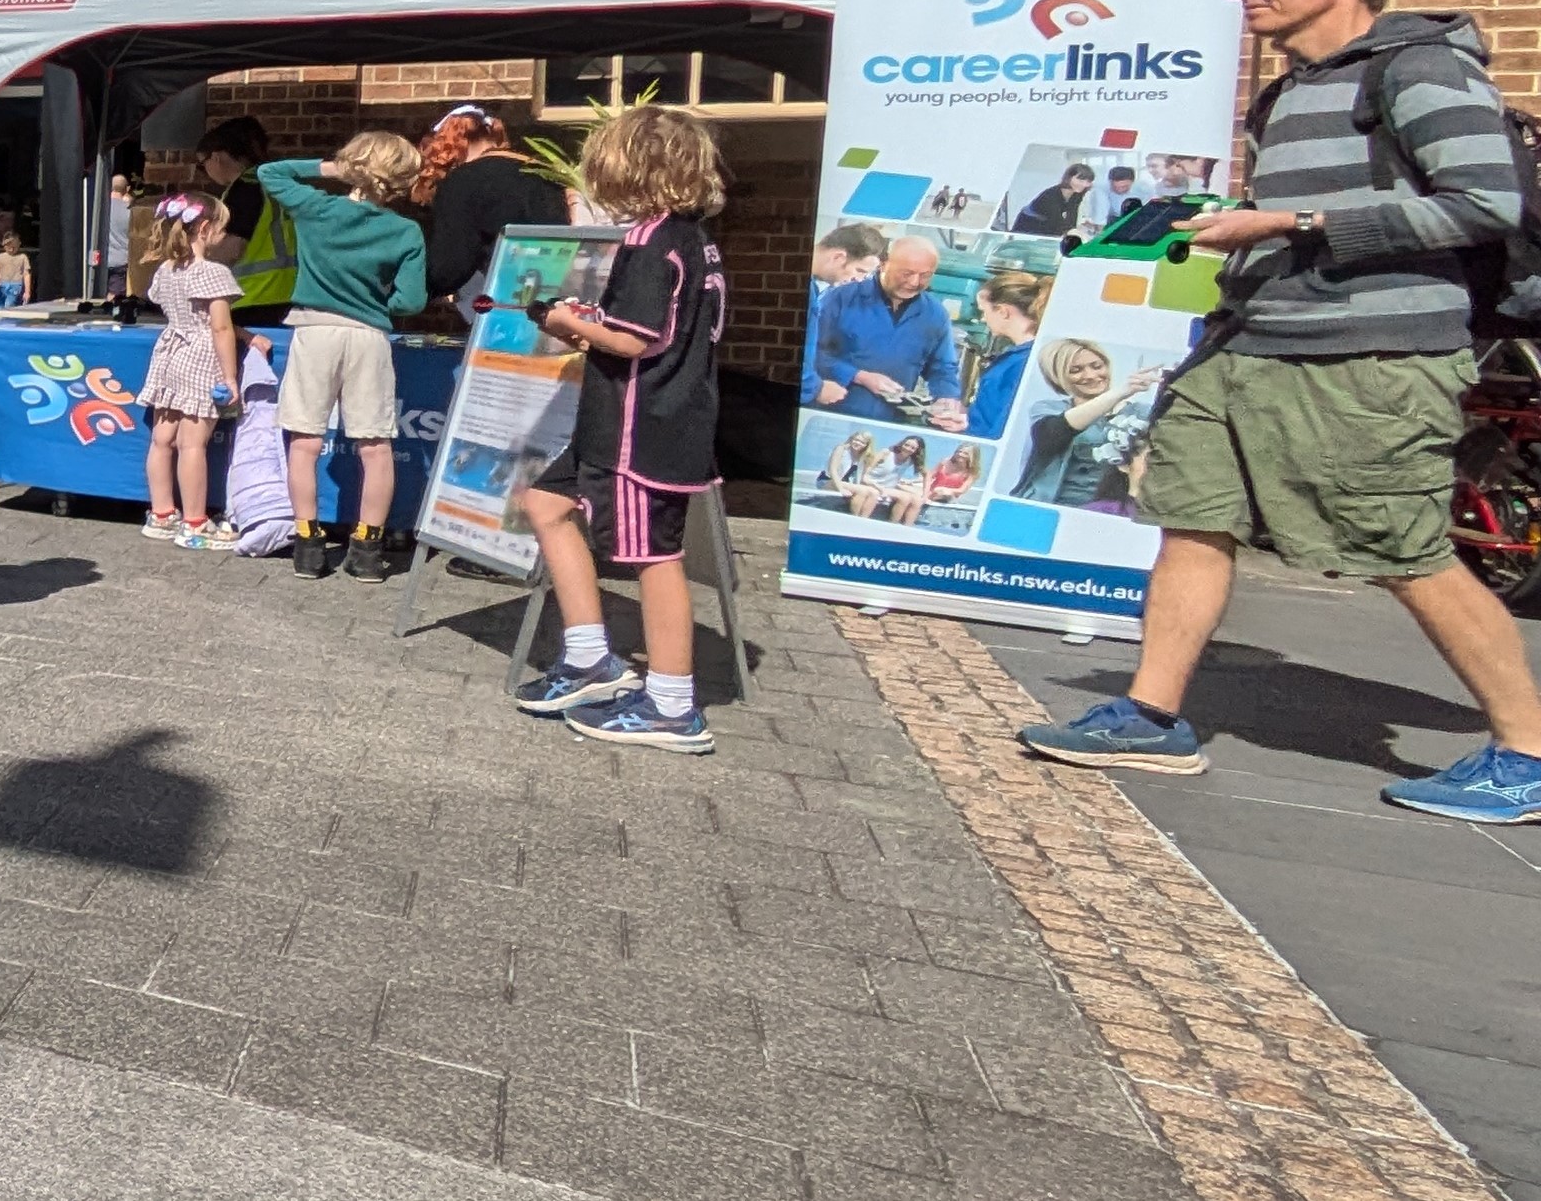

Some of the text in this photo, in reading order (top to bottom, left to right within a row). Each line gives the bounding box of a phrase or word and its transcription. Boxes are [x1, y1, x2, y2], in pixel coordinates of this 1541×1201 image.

[862, 42, 1204, 84] careerlinks
[884, 86, 1169, 107] young people, bright futures
[828, 552, 1143, 602] www.careerlinks.nsw.edu.au
